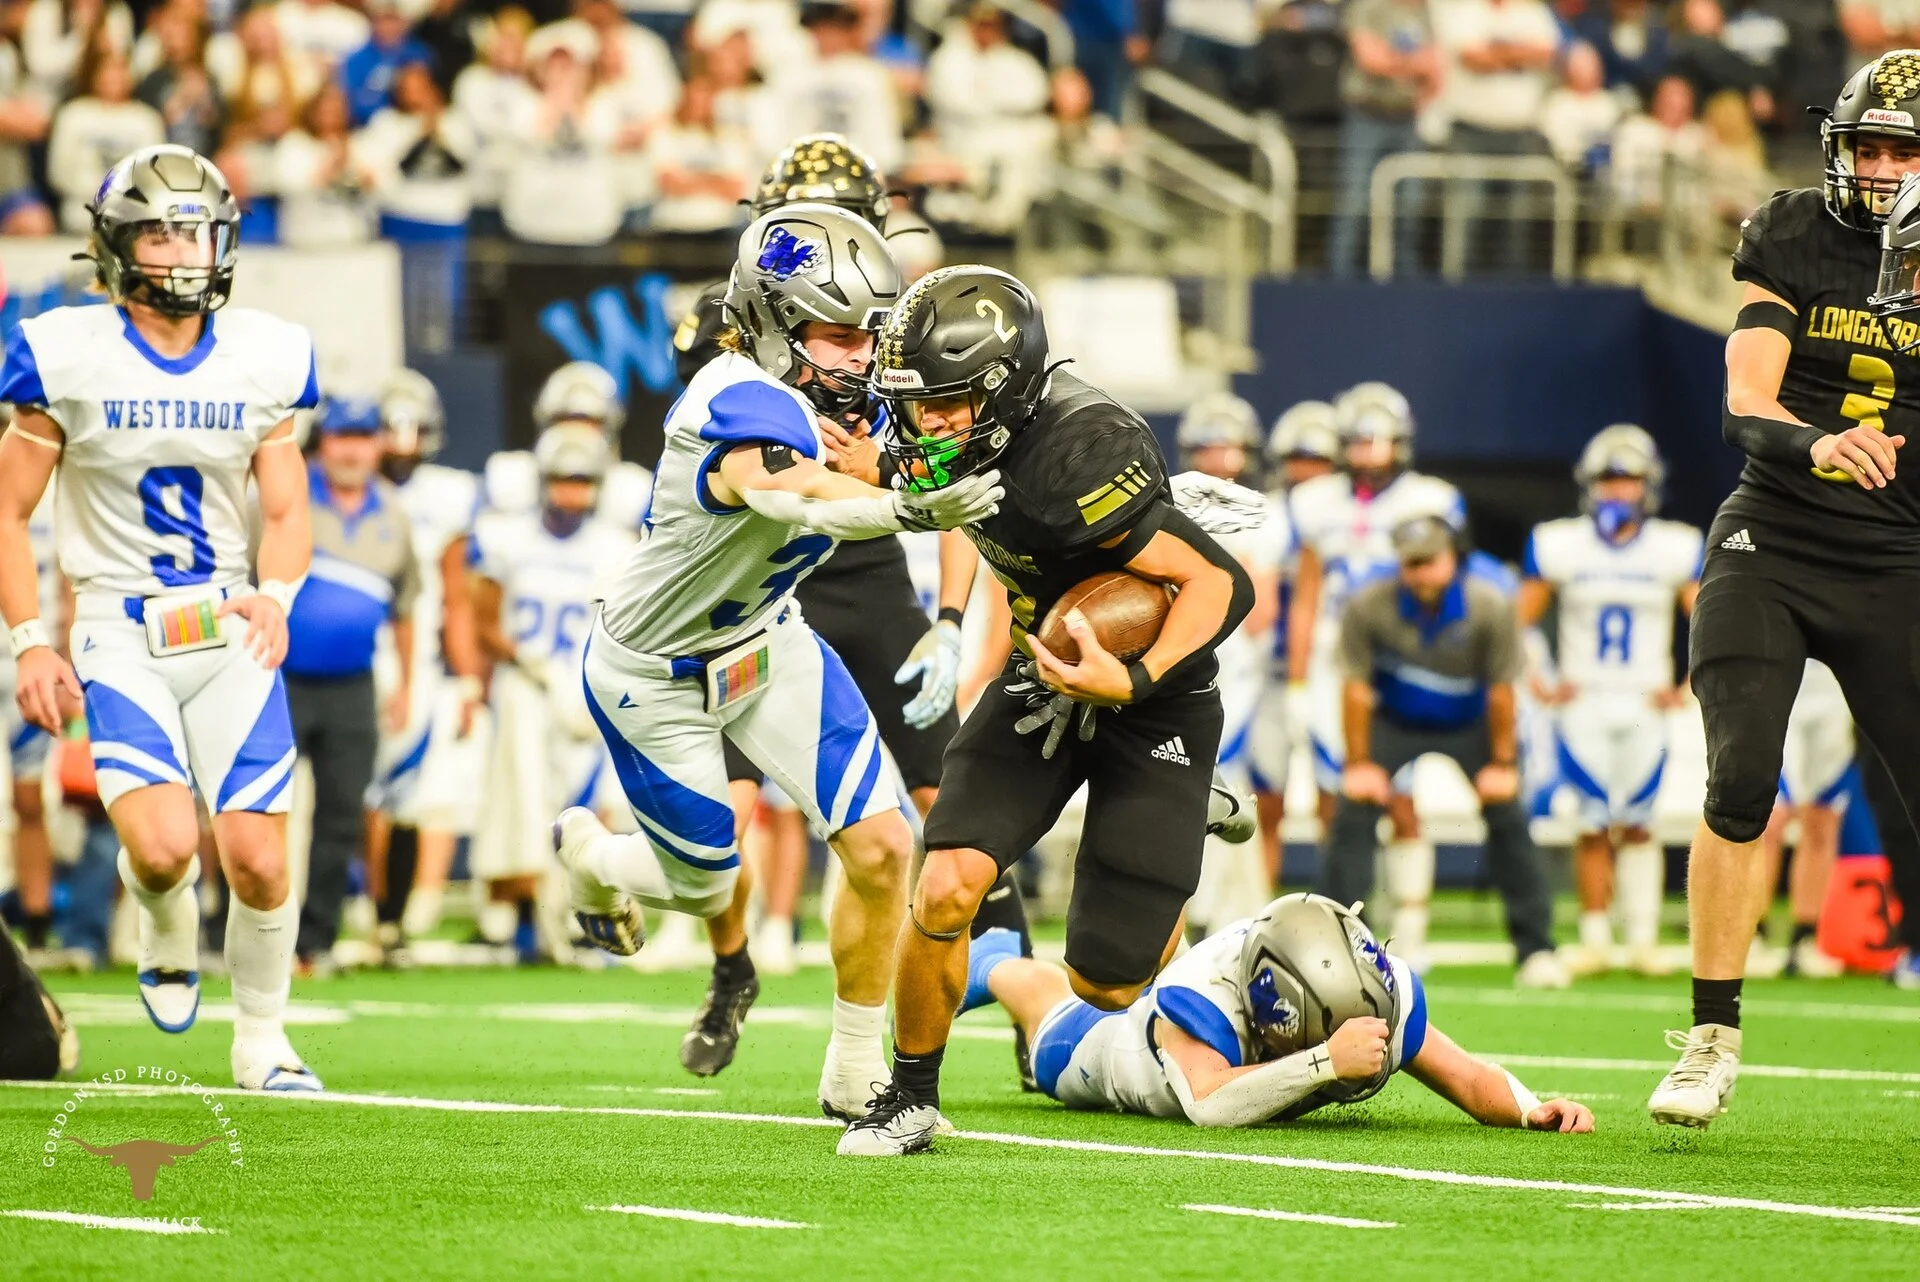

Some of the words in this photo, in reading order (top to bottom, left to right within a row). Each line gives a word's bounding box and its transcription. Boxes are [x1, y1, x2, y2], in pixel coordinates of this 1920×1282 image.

[1867, 111, 1907, 123] Riddell
[975, 299, 1018, 344] 2
[1807, 306, 1920, 358] LONGHOR
[884, 374, 914, 383] Riddell
[103, 400, 246, 431] WESTBROOK
[1811, 353, 1896, 484] 3
[138, 465, 217, 587] 9
[708, 532, 834, 631] 3
